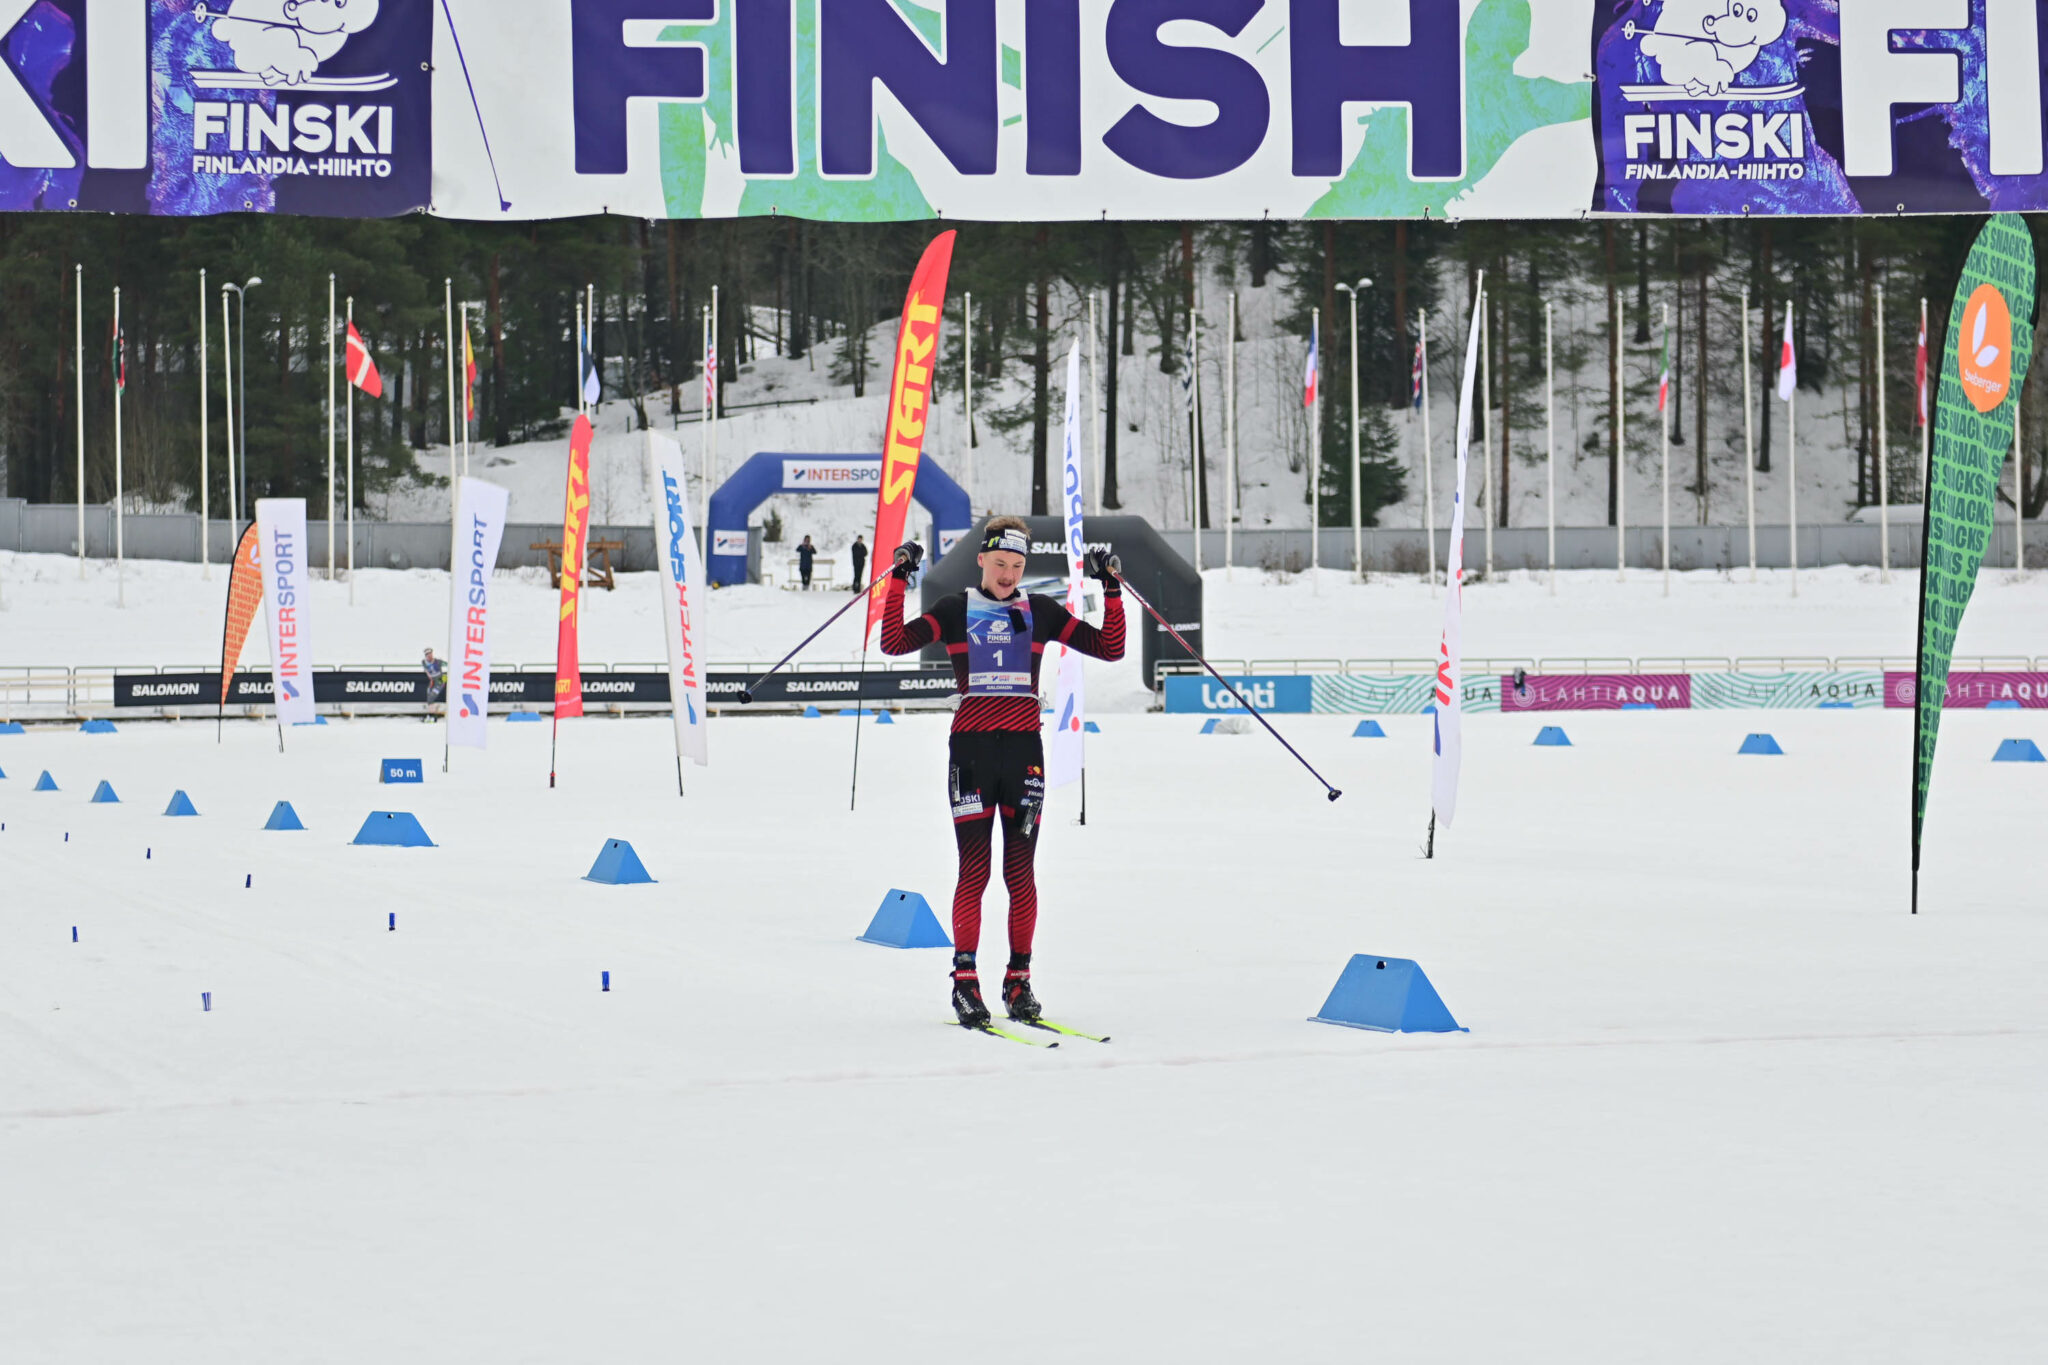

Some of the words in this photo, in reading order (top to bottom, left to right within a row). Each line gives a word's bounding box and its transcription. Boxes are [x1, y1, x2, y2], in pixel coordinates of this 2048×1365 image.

[572, 0, 1462, 180] FINISH
[193, 103, 393, 155] FINSKI
[1624, 112, 1805, 160] FINSKI
[192, 156, 392, 179] FINLANDIA-HIIHTO
[1624, 162, 1804, 181] FINLANDIA-HIIHTO
[883, 289, 939, 505] START
[808, 468, 880, 481] INTERSPO
[274, 529, 299, 676] INTERSPORT
[462, 512, 487, 690] INTERSPORT
[992, 650, 1003, 667] 1
[132, 683, 200, 696] SALOMON
[238, 682, 275, 694] SALO
[345, 681, 415, 693] SALOMON
[786, 680, 859, 692] SALOMON
[899, 678, 957, 690] SALOMO
[1201, 682, 1276, 710] Lahti
[390, 768, 404, 778] 50
